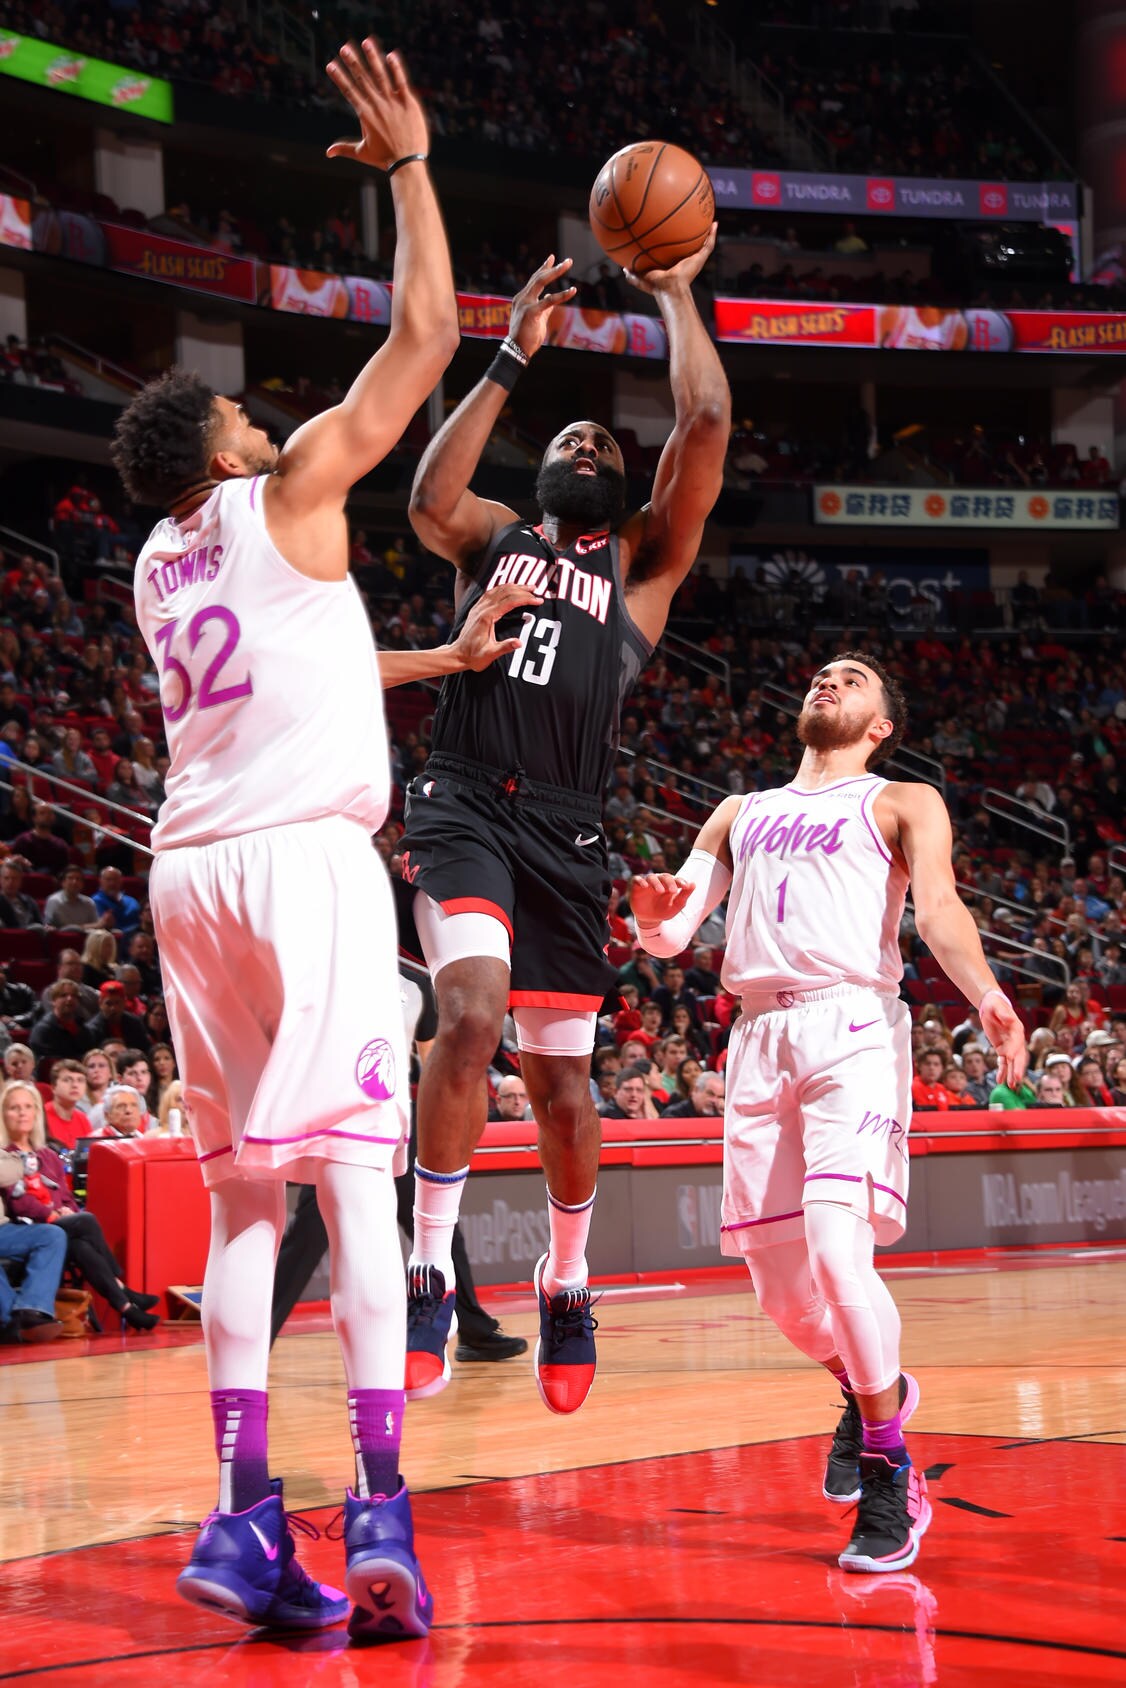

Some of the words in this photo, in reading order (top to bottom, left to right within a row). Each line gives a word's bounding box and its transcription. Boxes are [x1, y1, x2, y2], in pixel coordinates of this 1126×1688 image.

[786, 183, 850, 200] TUNDRA
[900, 189, 965, 206] TUNDRA
[1012, 193, 1072, 209] TUNDRA
[137, 250, 185, 277] FLASH
[743, 314, 799, 338] FLASH
[1045, 325, 1096, 349] FLASH
[147, 545, 224, 602] TOWNS
[507, 611, 563, 686] 13
[154, 604, 254, 722] 32
[739, 813, 850, 862] Wolves
[776, 871, 790, 923] 1
